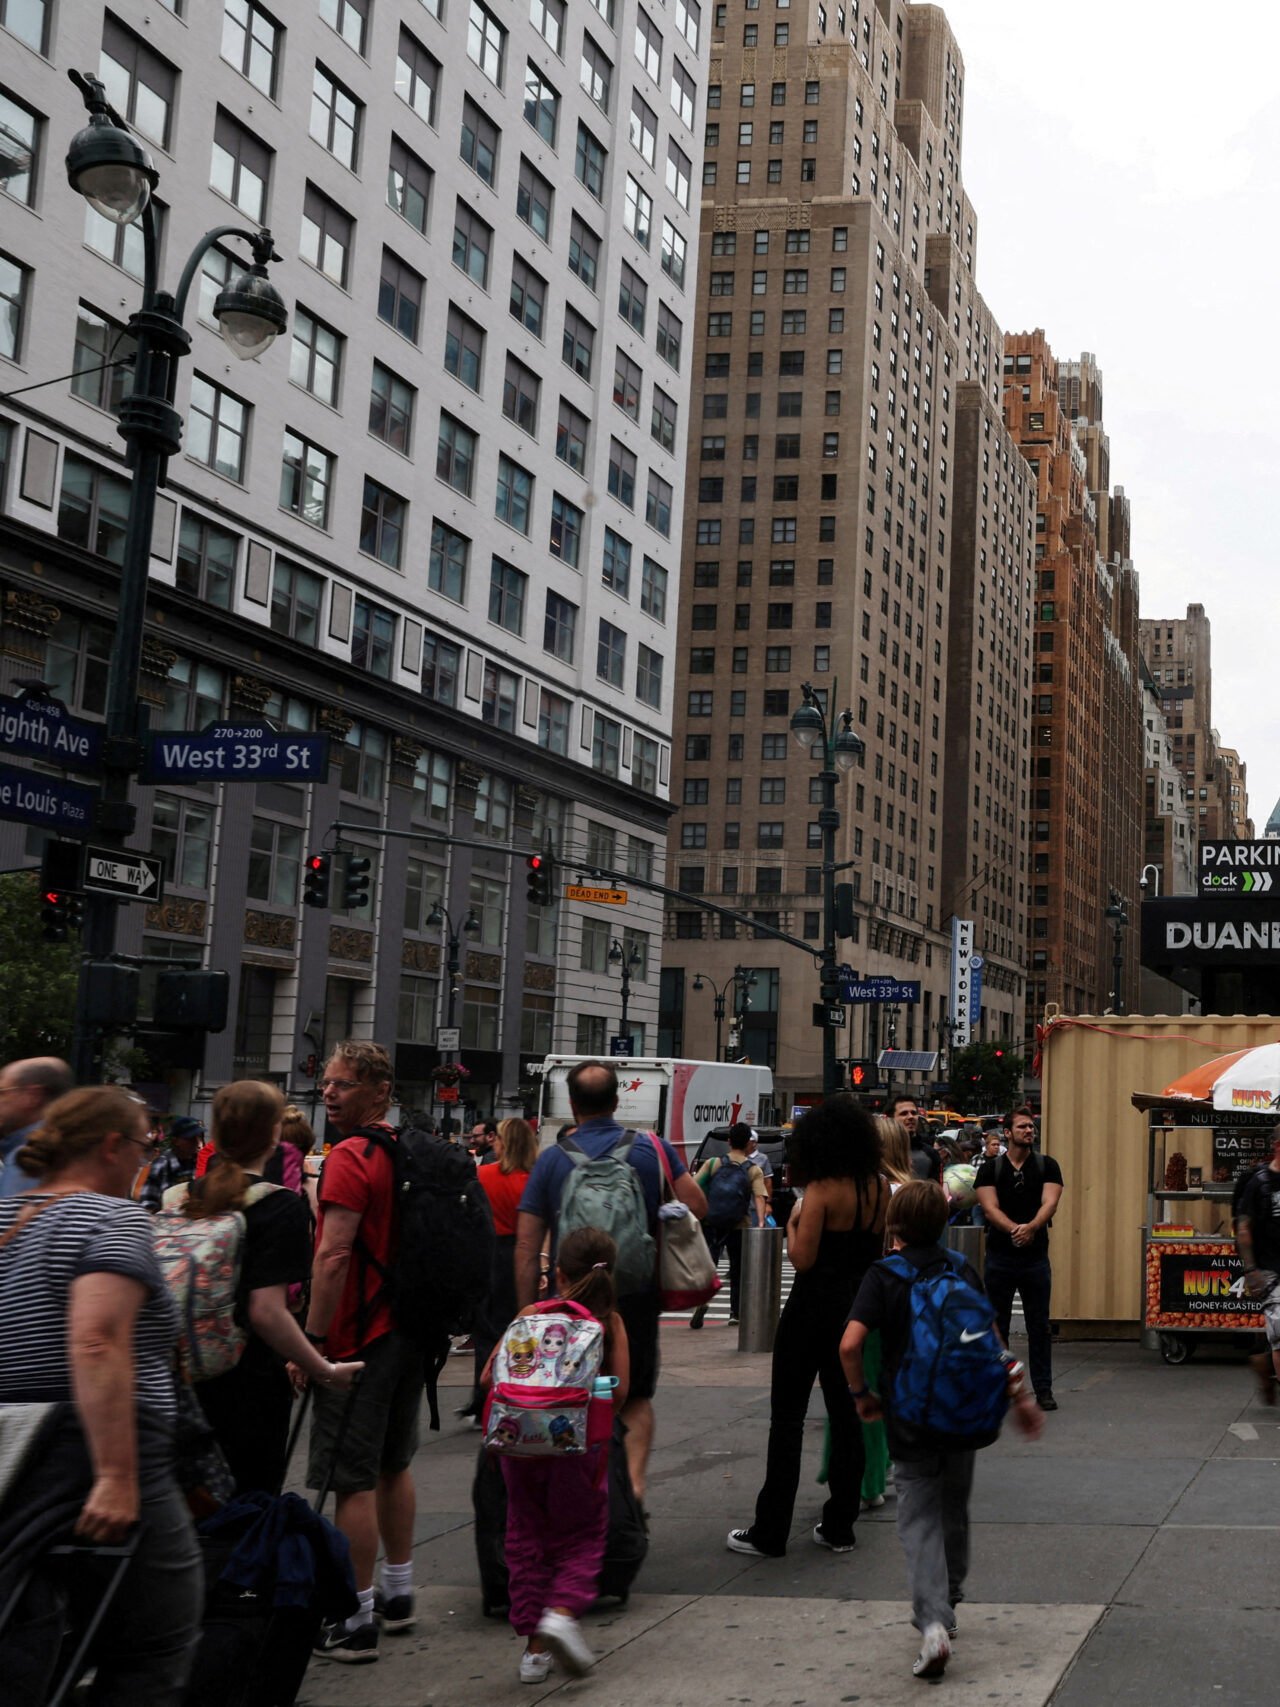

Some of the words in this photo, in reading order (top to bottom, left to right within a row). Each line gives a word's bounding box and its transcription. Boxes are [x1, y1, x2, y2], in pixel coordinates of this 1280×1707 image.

[0, 706, 50, 746] ighth
[53, 725, 90, 756] Ave
[213, 728, 234, 739] 270
[243, 728, 263, 739] 200
[162, 744, 226, 769] West
[232, 743, 279, 769] 33rd
[285, 745, 311, 769] St
[16, 782, 58, 815] Louis
[61, 800, 86, 820] Plaza
[97, 861, 118, 880] ONE
[127, 867, 150, 885] WAY
[1202, 871, 1238, 886] dock
[570, 888, 591, 898] DEAD
[593, 891, 609, 900] END
[958, 923, 969, 959] NEW
[849, 986, 877, 998] West
[879, 986, 899, 998] 33rd
[902, 986, 913, 998] St
[957, 967, 968, 1044] YORKER
[694, 1099, 730, 1122] aramark
[1215, 1137, 1266, 1149] CASS
[1211, 1259, 1226, 1267] ALL
[1183, 1269, 1252, 1298] NUTS4
[1189, 1300, 1262, 1311] HONEY-ROASTED
